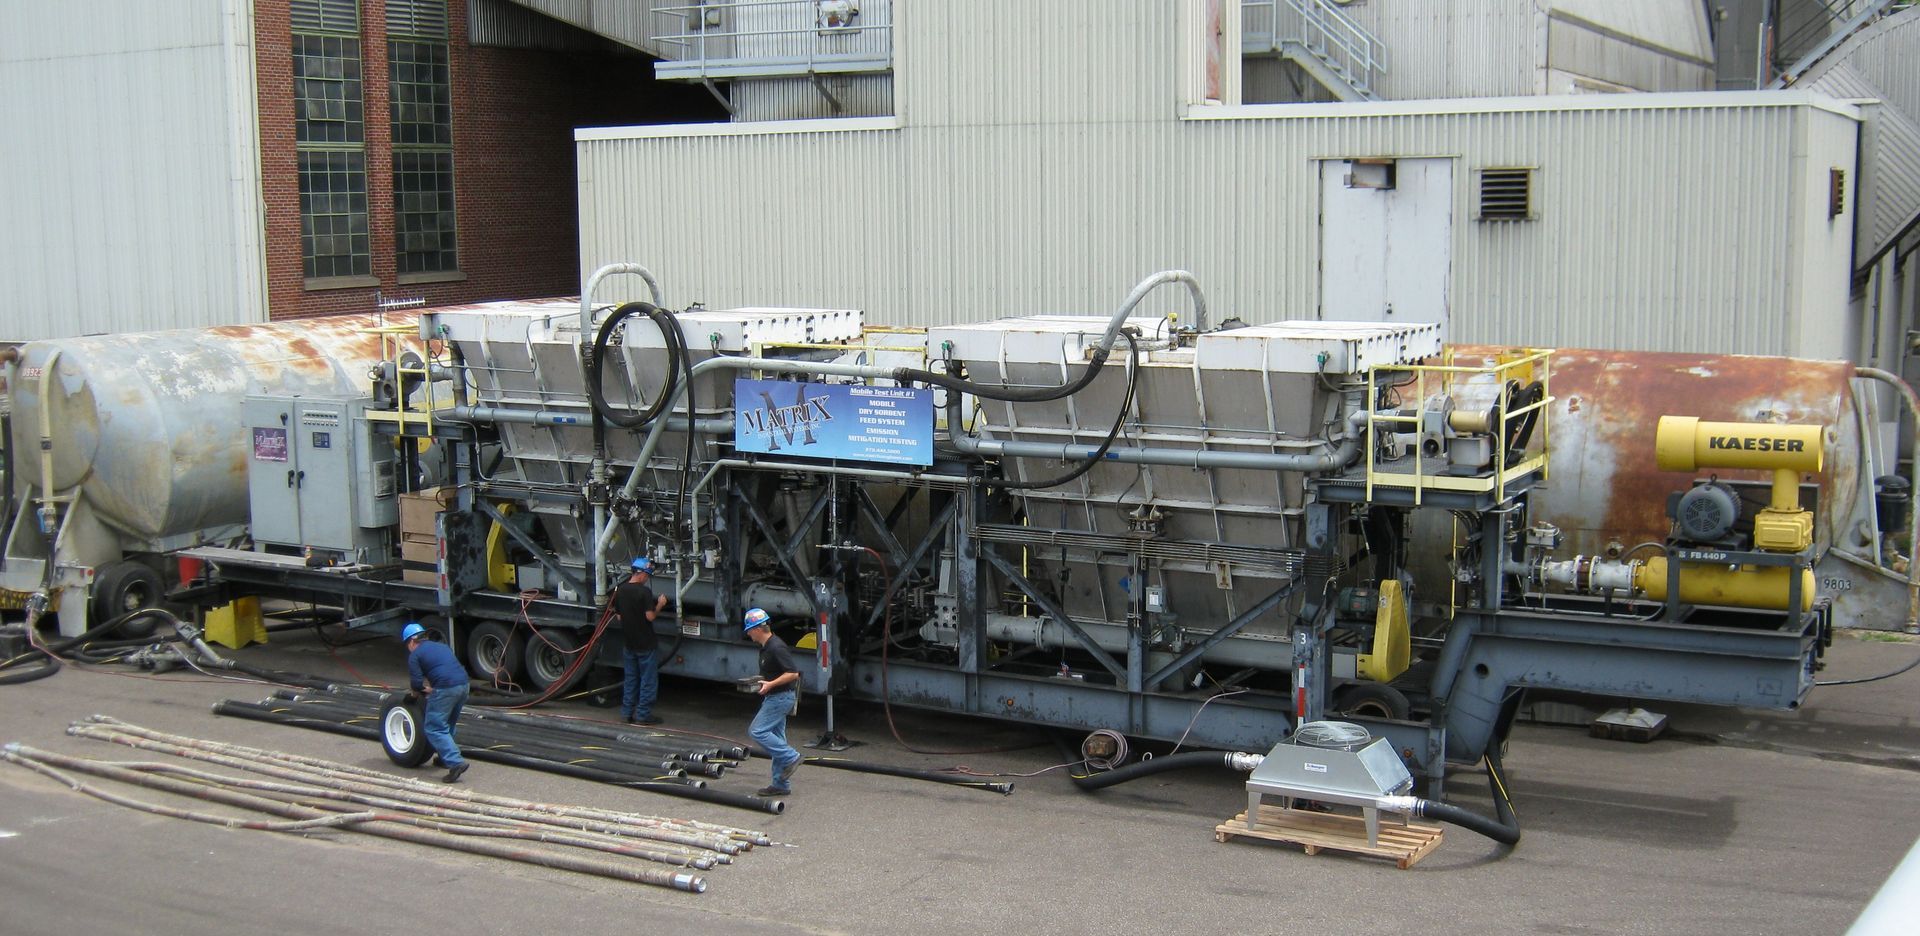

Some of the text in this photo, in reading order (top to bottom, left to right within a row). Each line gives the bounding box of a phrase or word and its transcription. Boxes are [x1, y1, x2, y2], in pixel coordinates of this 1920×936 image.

[850, 387, 874, 395] Mobile
[874, 388, 889, 396] Test
[890, 389, 904, 397] Unit
[869, 399, 896, 408] MOBILE
[743, 395, 833, 436] MATRIX
[874, 409, 906, 417] SORBENT
[878, 418, 905, 426] SYSTEM
[866, 427, 899, 436] EMISSION
[848, 435, 917, 446] MITIGATION TESTING
[1709, 436, 1804, 452] KAESER
[1690, 551, 1701, 559] FB
[820, 582, 826, 594] 2
[1824, 578, 1851, 590] 9803
[1300, 632, 1306, 645] 3
